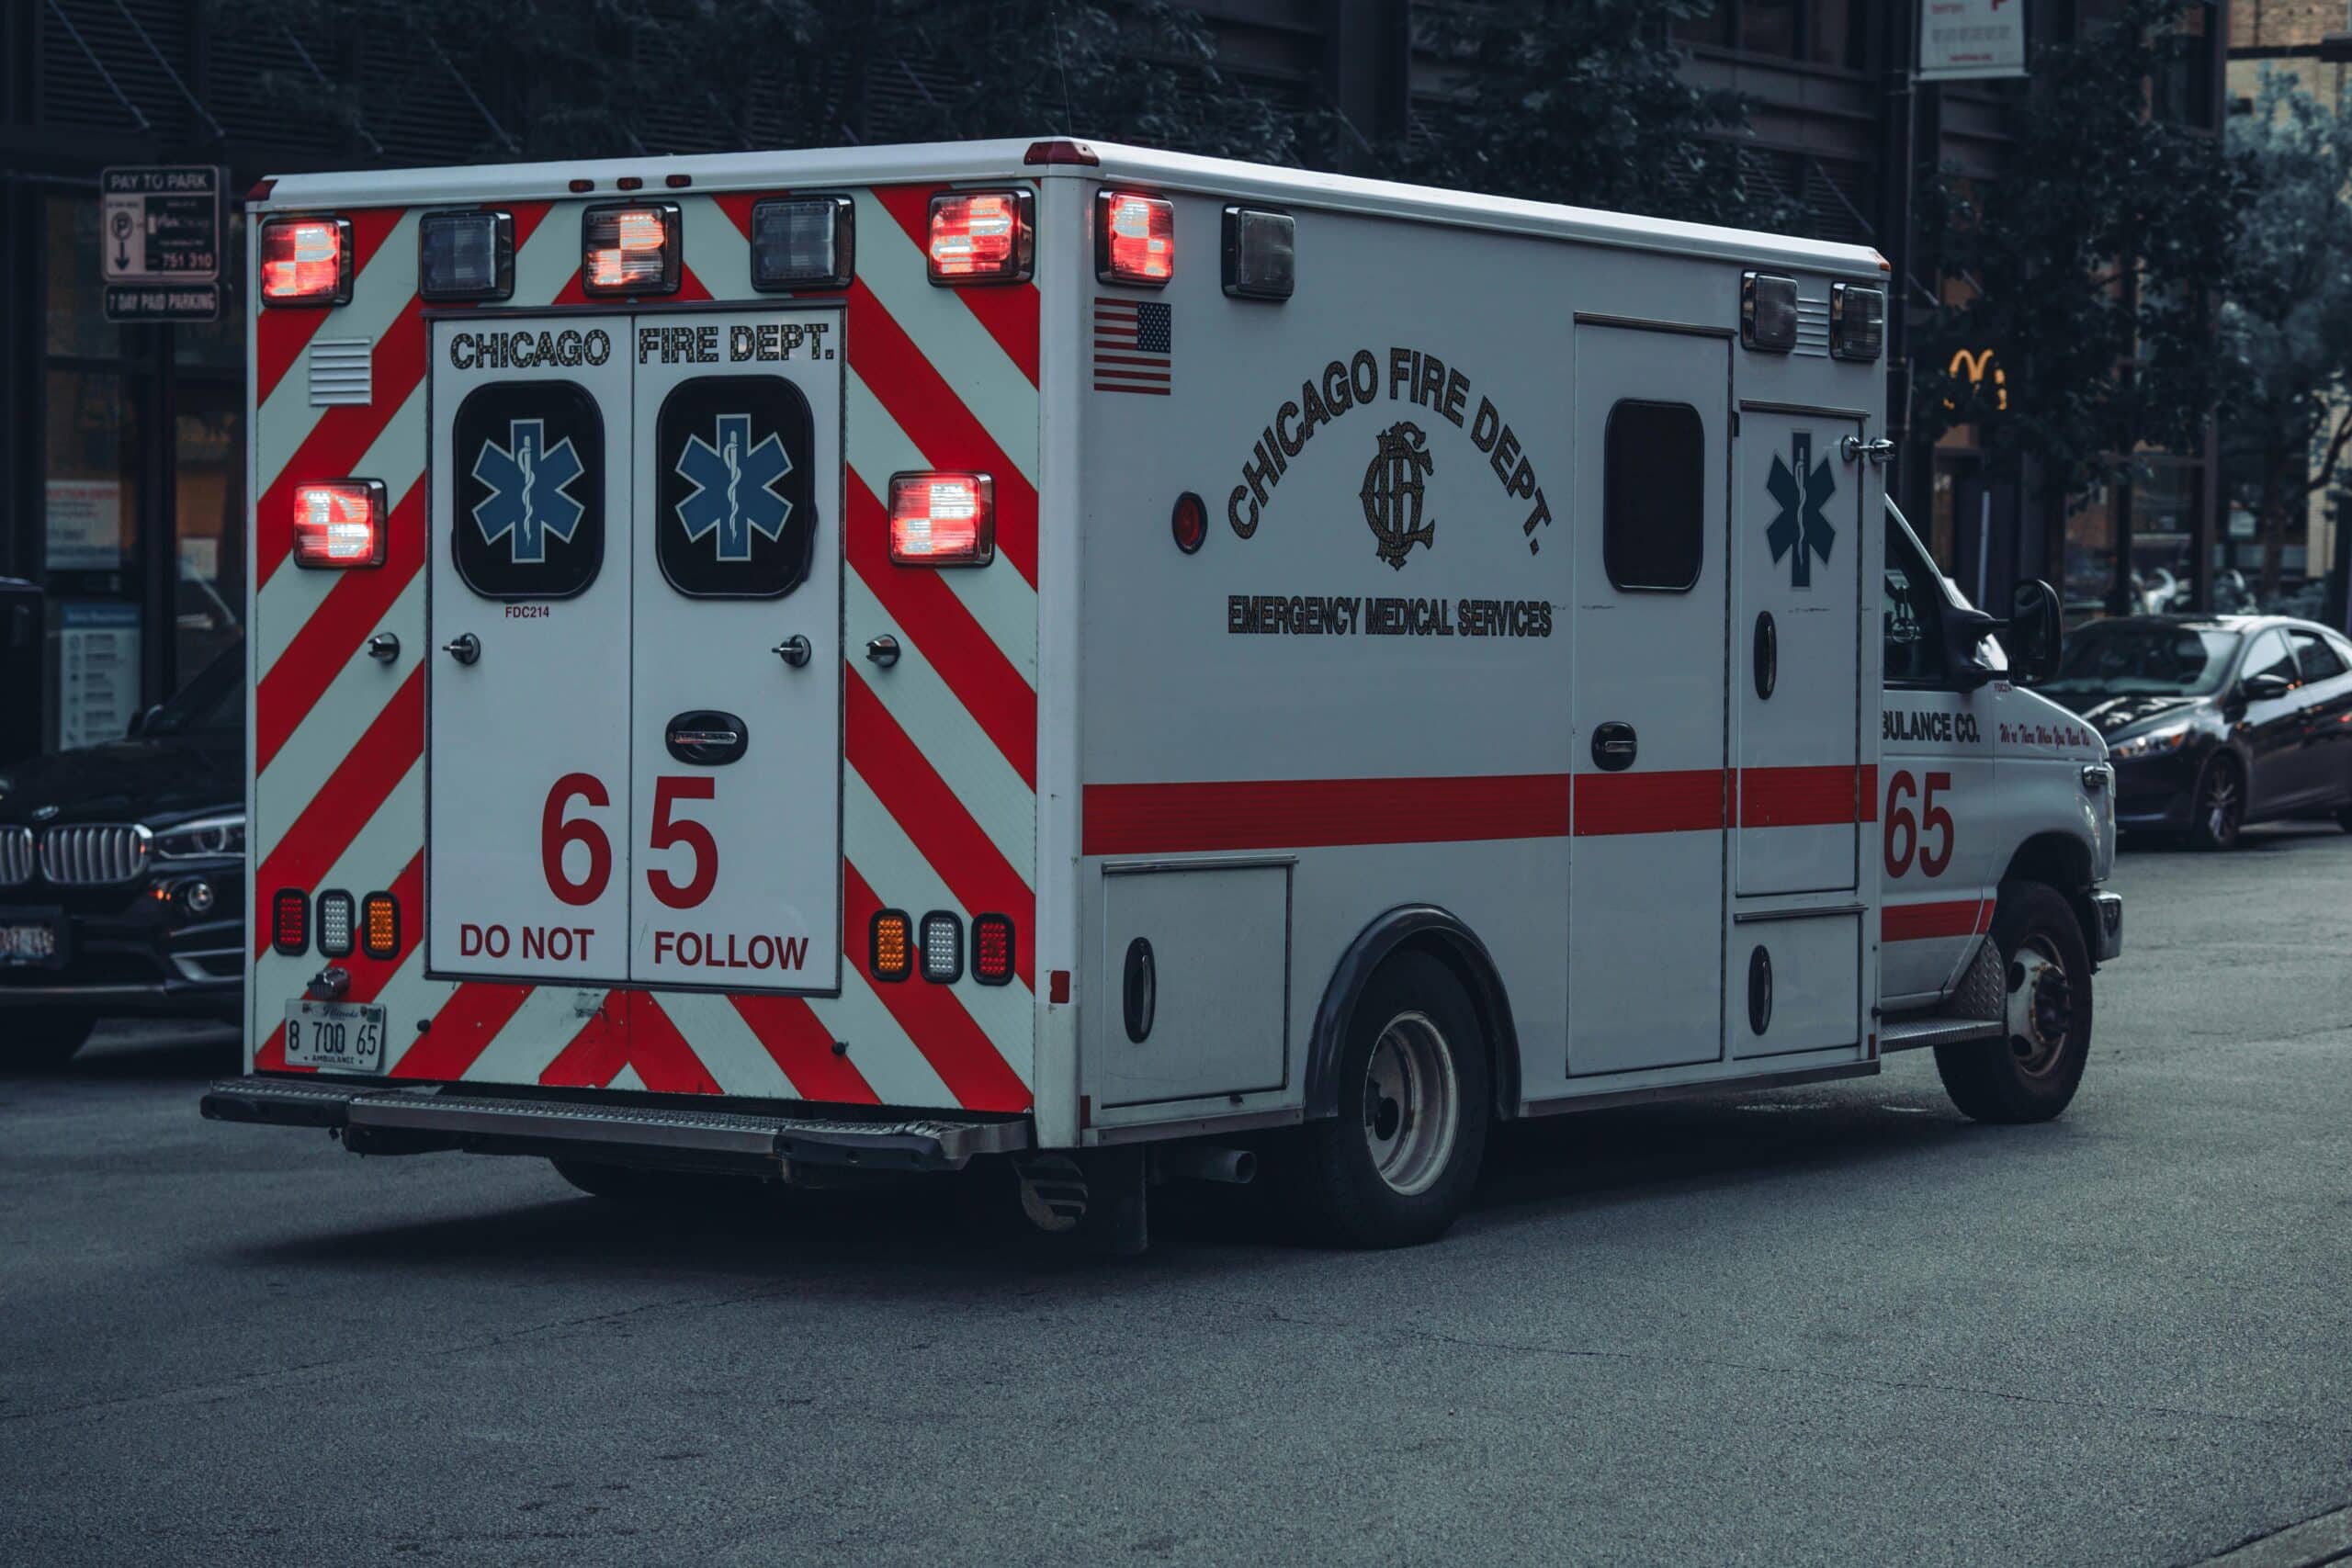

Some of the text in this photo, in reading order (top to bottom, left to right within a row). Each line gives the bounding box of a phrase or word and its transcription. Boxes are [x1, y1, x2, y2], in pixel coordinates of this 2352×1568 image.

[111, 173, 207, 189] PAY TO PARK
[168, 291, 215, 310] PARKING
[450, 322, 835, 370] CHICAGO FIRE DEPT.
[1227, 347, 1553, 557] CHICAGO FIRE DEPT.
[504, 604, 550, 619] FDC214
[1227, 594, 1553, 638] EMERGENCY MEDICAL SERVICES
[1954, 712, 1981, 743] CO.
[1883, 769, 1955, 879] 65
[460, 923, 809, 971] DO NOT FOLLOW
[288, 1020, 300, 1051] 8
[356, 1024, 378, 1055] 65
[311, 1054, 355, 1065] AMBULANCE
